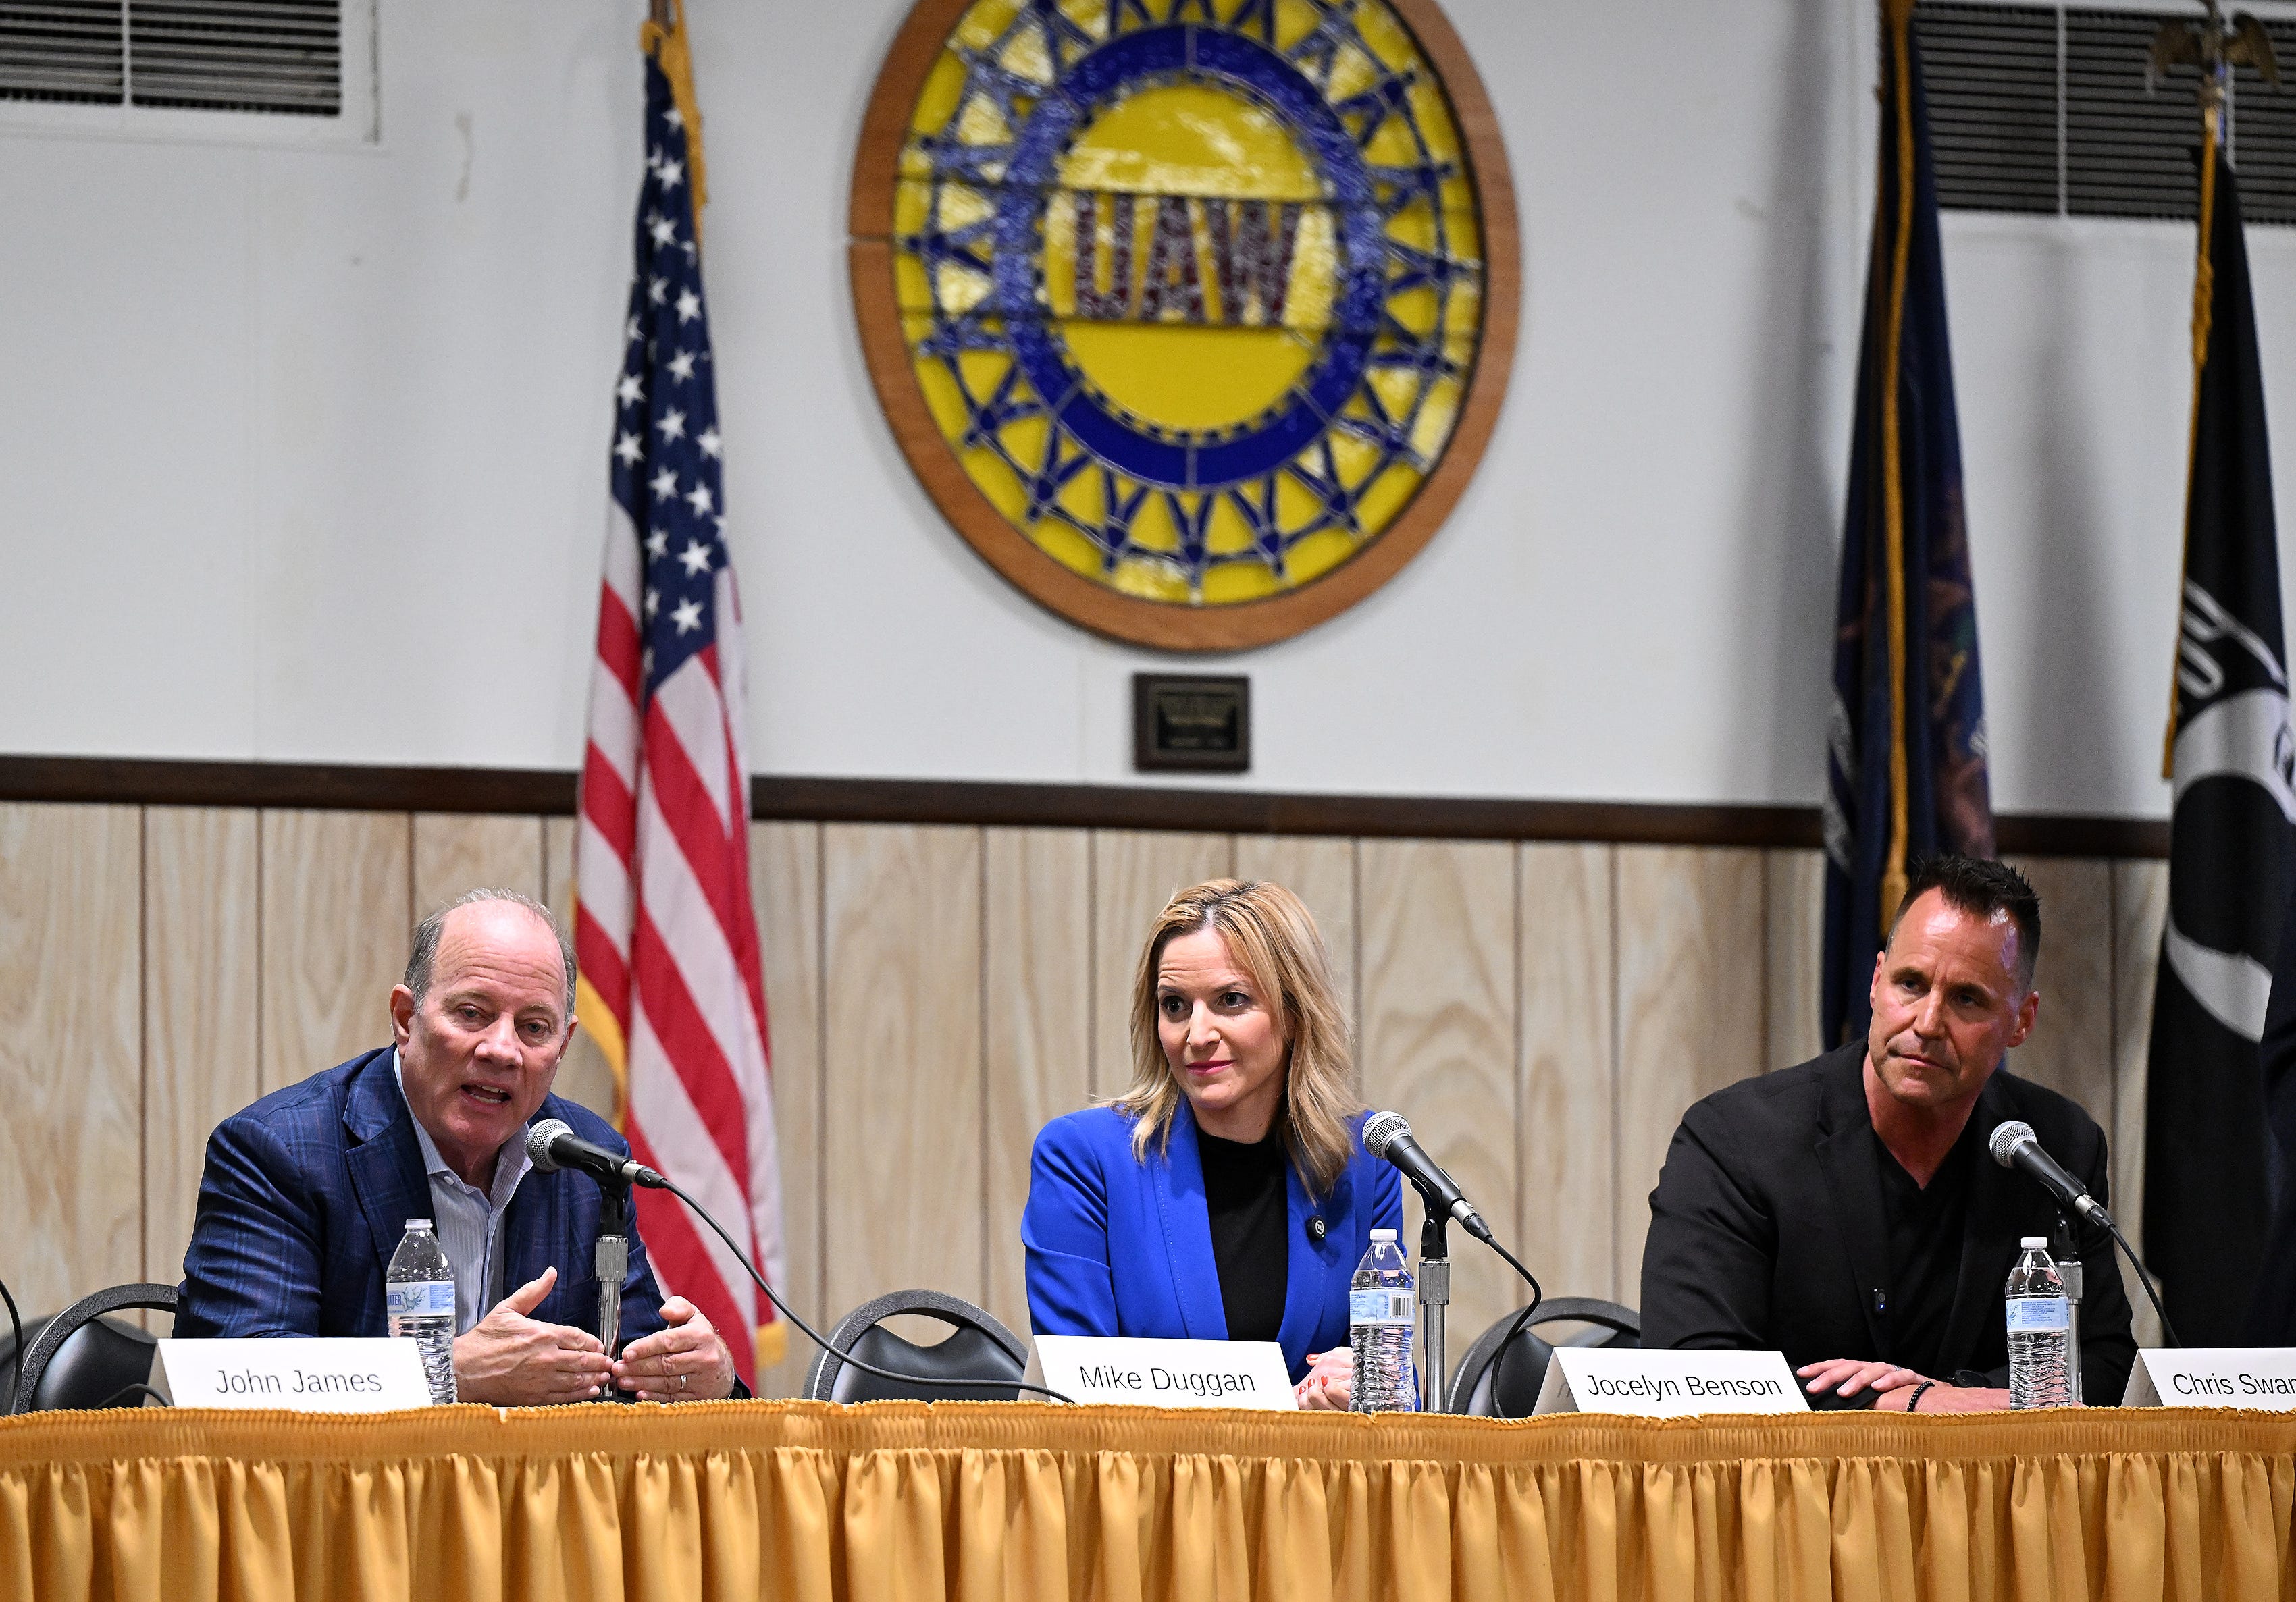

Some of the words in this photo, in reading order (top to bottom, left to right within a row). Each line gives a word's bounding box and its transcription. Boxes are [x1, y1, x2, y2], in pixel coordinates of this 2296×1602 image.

[1075, 189, 1301, 325] UAW
[216, 1369, 282, 1393] John
[292, 1370, 382, 1393] James
[1079, 1365, 1142, 1390] Mike
[1150, 1367, 1255, 1397] Duggan
[1587, 1374, 1681, 1401] Jocelyn
[1684, 1376, 1783, 1396] Benson
[2172, 1372, 2235, 1395] Chris
